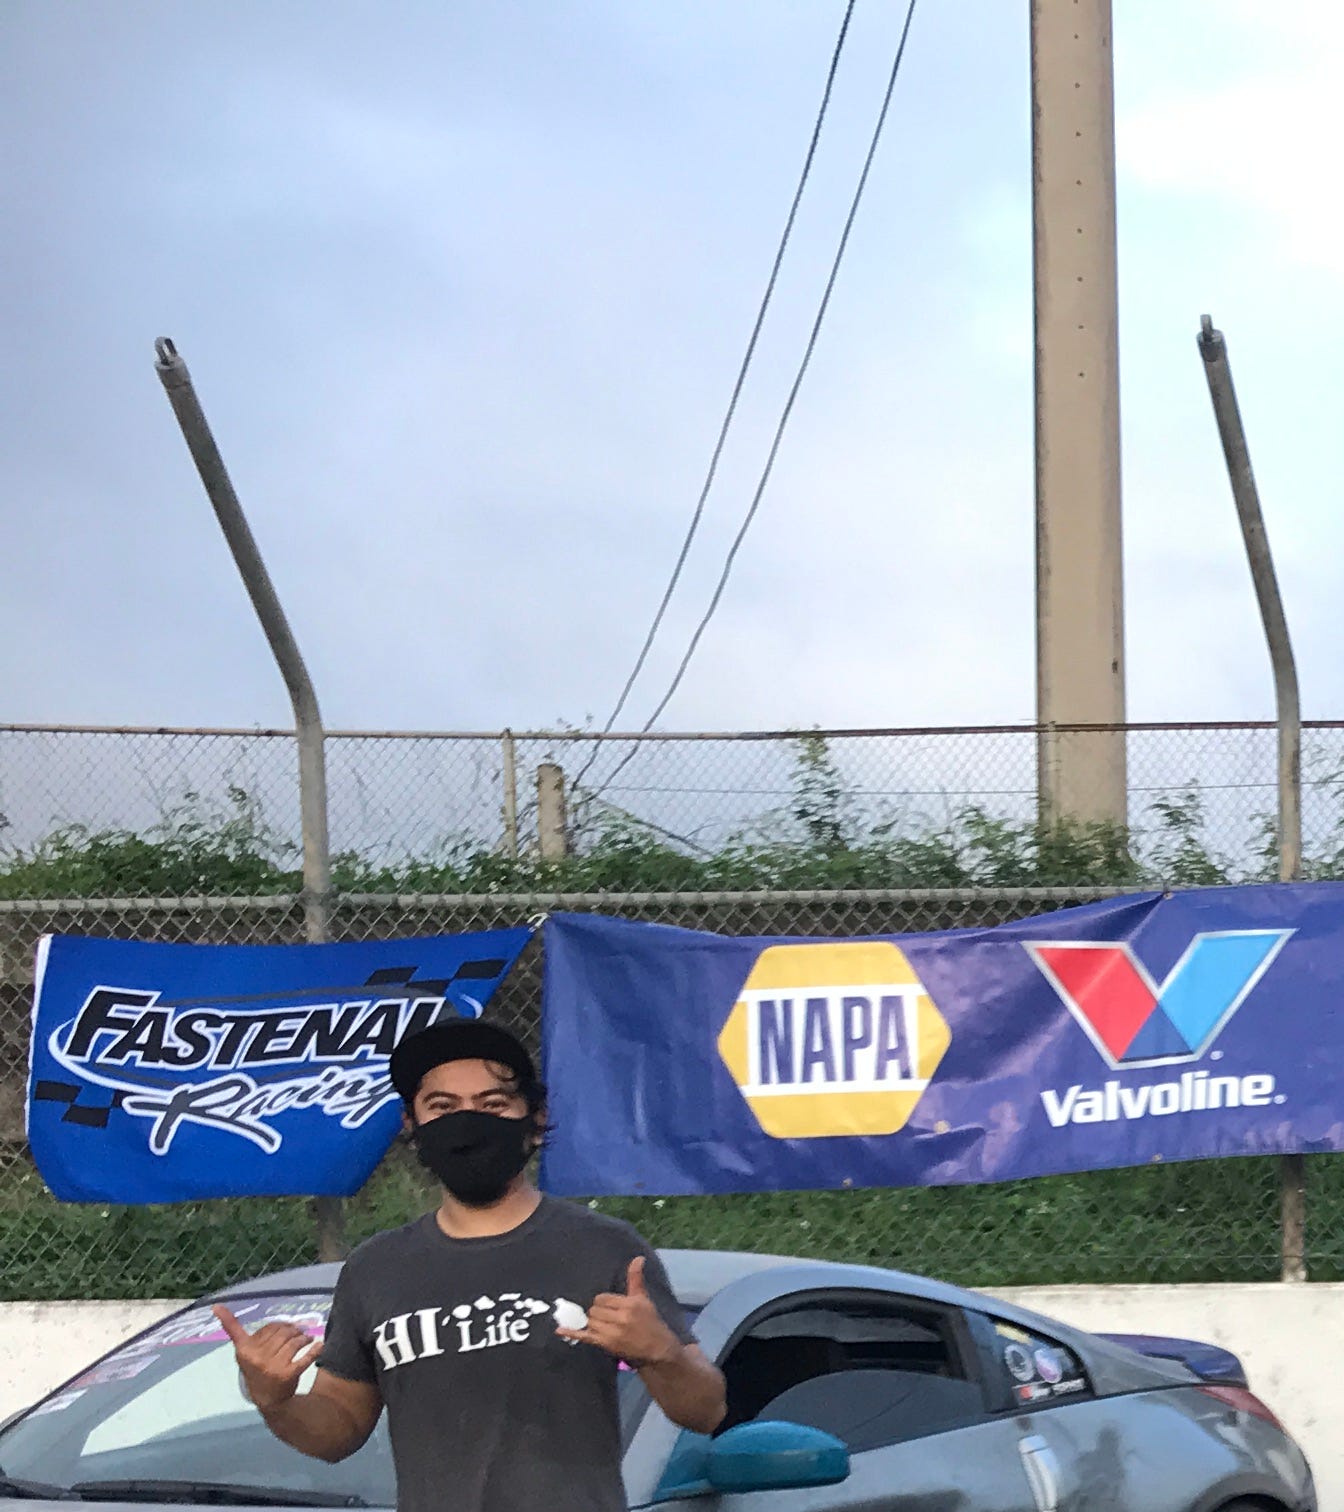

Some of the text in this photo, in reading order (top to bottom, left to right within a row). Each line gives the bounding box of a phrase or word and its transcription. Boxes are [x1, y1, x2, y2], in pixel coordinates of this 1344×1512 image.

[758, 994, 915, 1086] NAPA
[122, 1066, 402, 1156] Racing
[372, 1307, 531, 1371] HI Life
